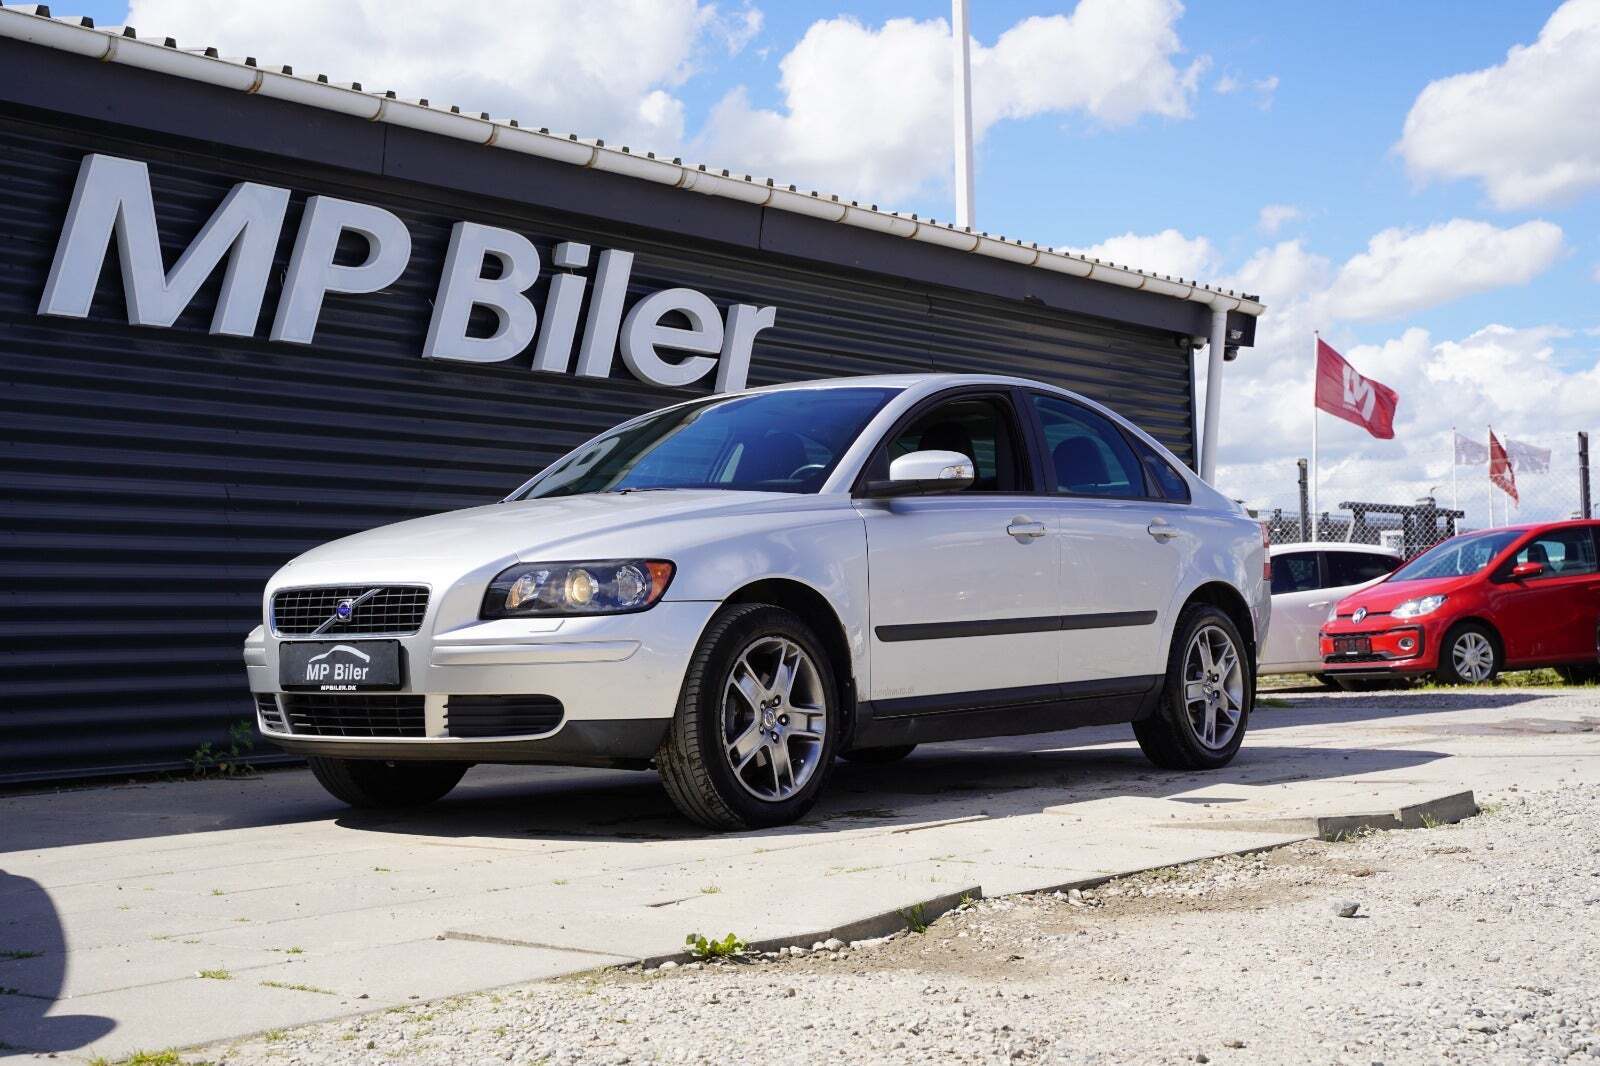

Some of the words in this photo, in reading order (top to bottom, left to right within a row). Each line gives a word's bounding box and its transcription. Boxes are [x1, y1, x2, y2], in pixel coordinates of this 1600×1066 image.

[37, 153, 411, 344] MP
[421, 220, 776, 393] Biler
[306, 664, 330, 680] MP
[334, 663, 369, 680] Biler
